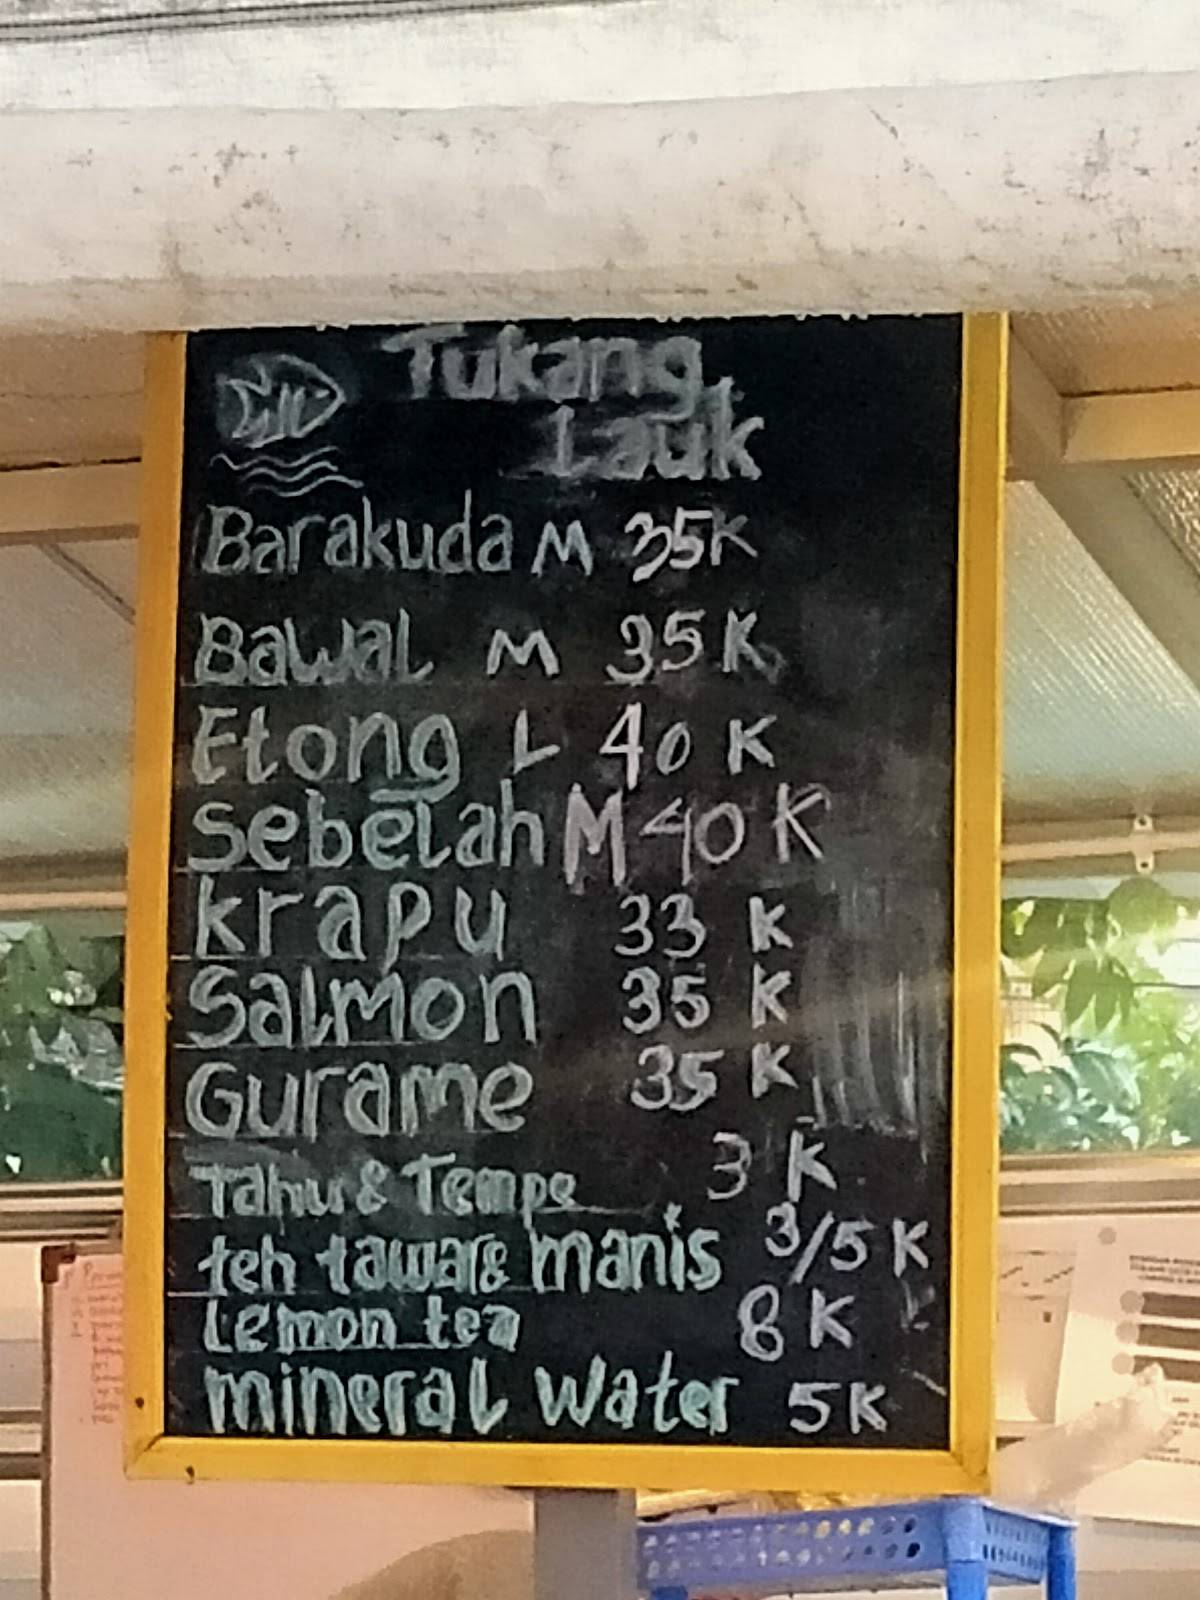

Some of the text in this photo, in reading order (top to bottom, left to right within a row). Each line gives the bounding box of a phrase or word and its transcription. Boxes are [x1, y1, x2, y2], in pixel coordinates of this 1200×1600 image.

[204, 489, 513, 574] Barakuda
[531, 519, 593, 575] M
[487, 628, 561, 678] M
[605, 610, 708, 685] 35
[722, 608, 770, 677] K
[192, 702, 778, 802] Etong L 40 K
[563, 783, 626, 893] M
[640, 797, 747, 885] 40
[772, 783, 832, 862] K
[614, 894, 705, 958] 33
[748, 896, 793, 952] K
[621, 970, 710, 1033] 35
[751, 962, 792, 1030] K
[186, 1041, 799, 1143] Gurame 35 K
[189, 1162, 346, 1220] Tahu
[402, 1152, 578, 1235] Tempe
[706, 1131, 752, 1201] 3
[787, 1129, 838, 1202] K
[198, 1234, 297, 1296] teh
[528, 1201, 722, 1295] manis
[764, 1201, 878, 1287] 3/5
[893, 1217, 930, 1278] K
[423, 1294, 521, 1353] tea
[738, 1283, 785, 1363] 8
[810, 1287, 856, 1350] K
[787, 1380, 842, 1435] 5
[849, 1380, 888, 1436] K
